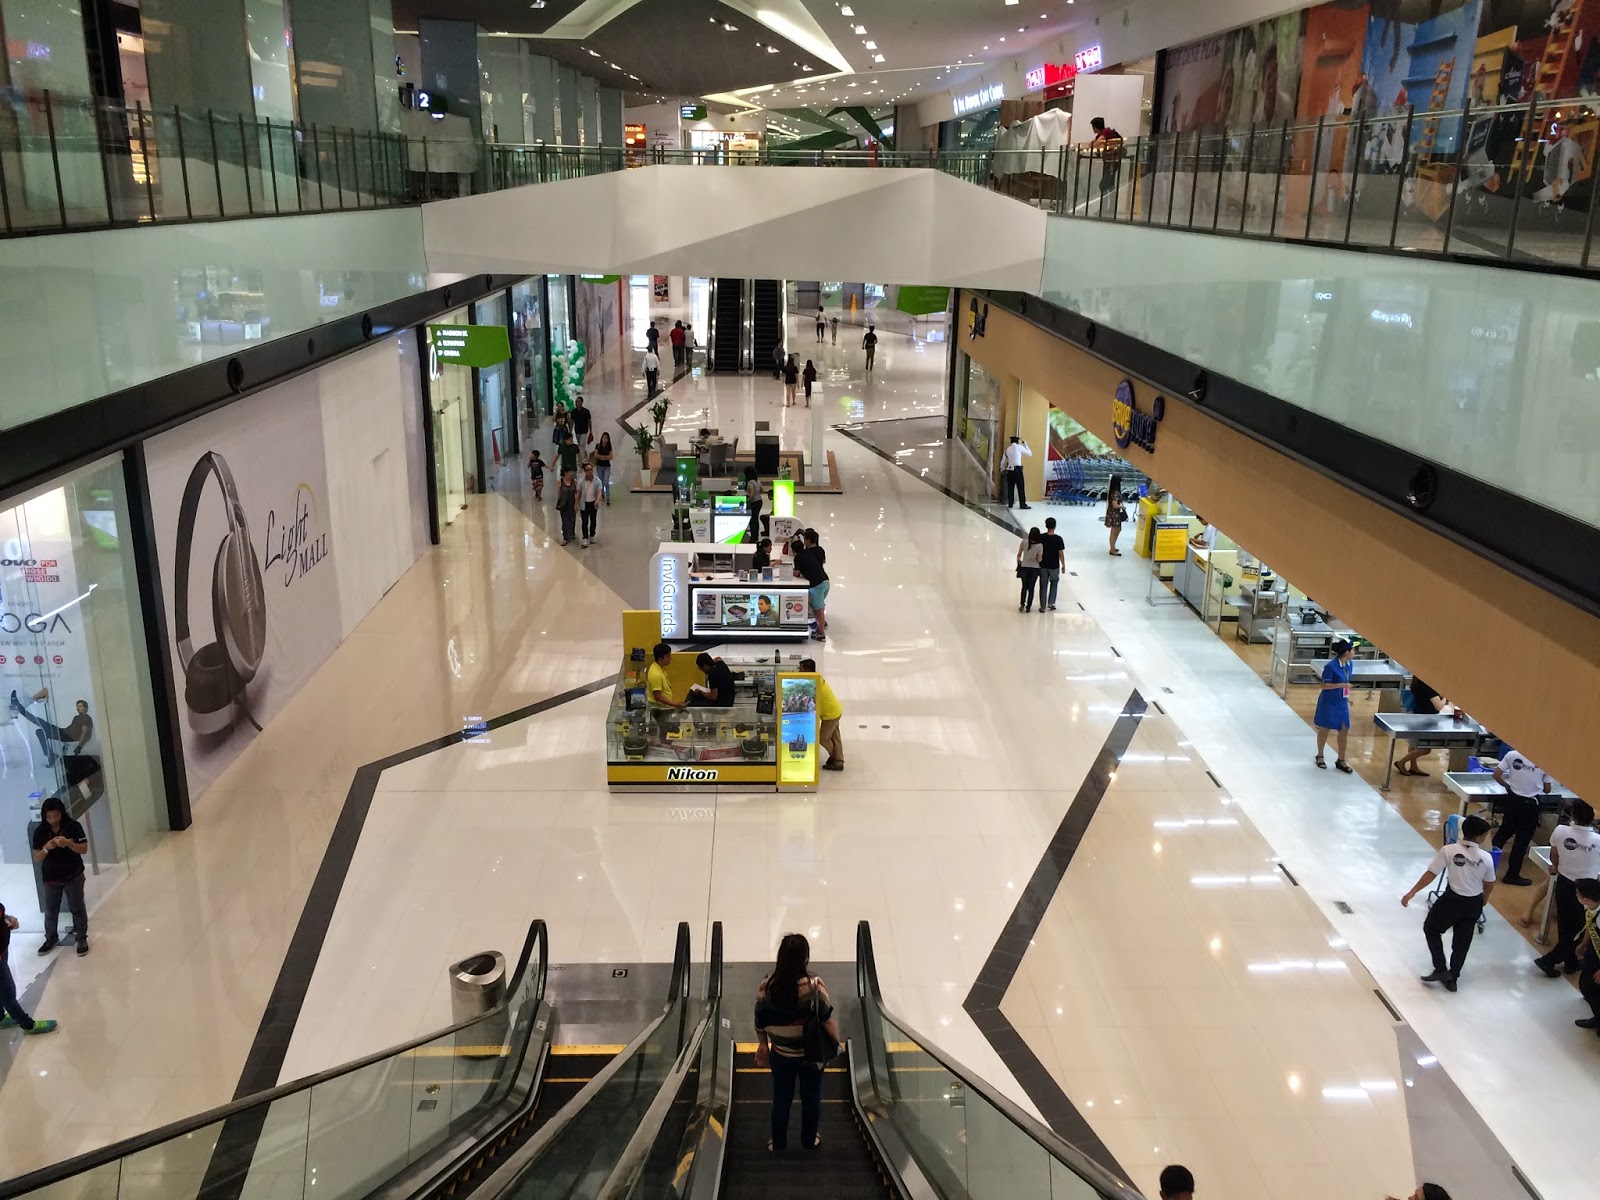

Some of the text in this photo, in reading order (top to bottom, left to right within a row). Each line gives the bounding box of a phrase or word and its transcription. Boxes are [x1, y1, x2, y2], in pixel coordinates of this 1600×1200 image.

[419, 92, 429, 107] 2
[265, 490, 308, 587] Light
[299, 533, 328, 578] MALL
[668, 768, 717, 780] Nikon
